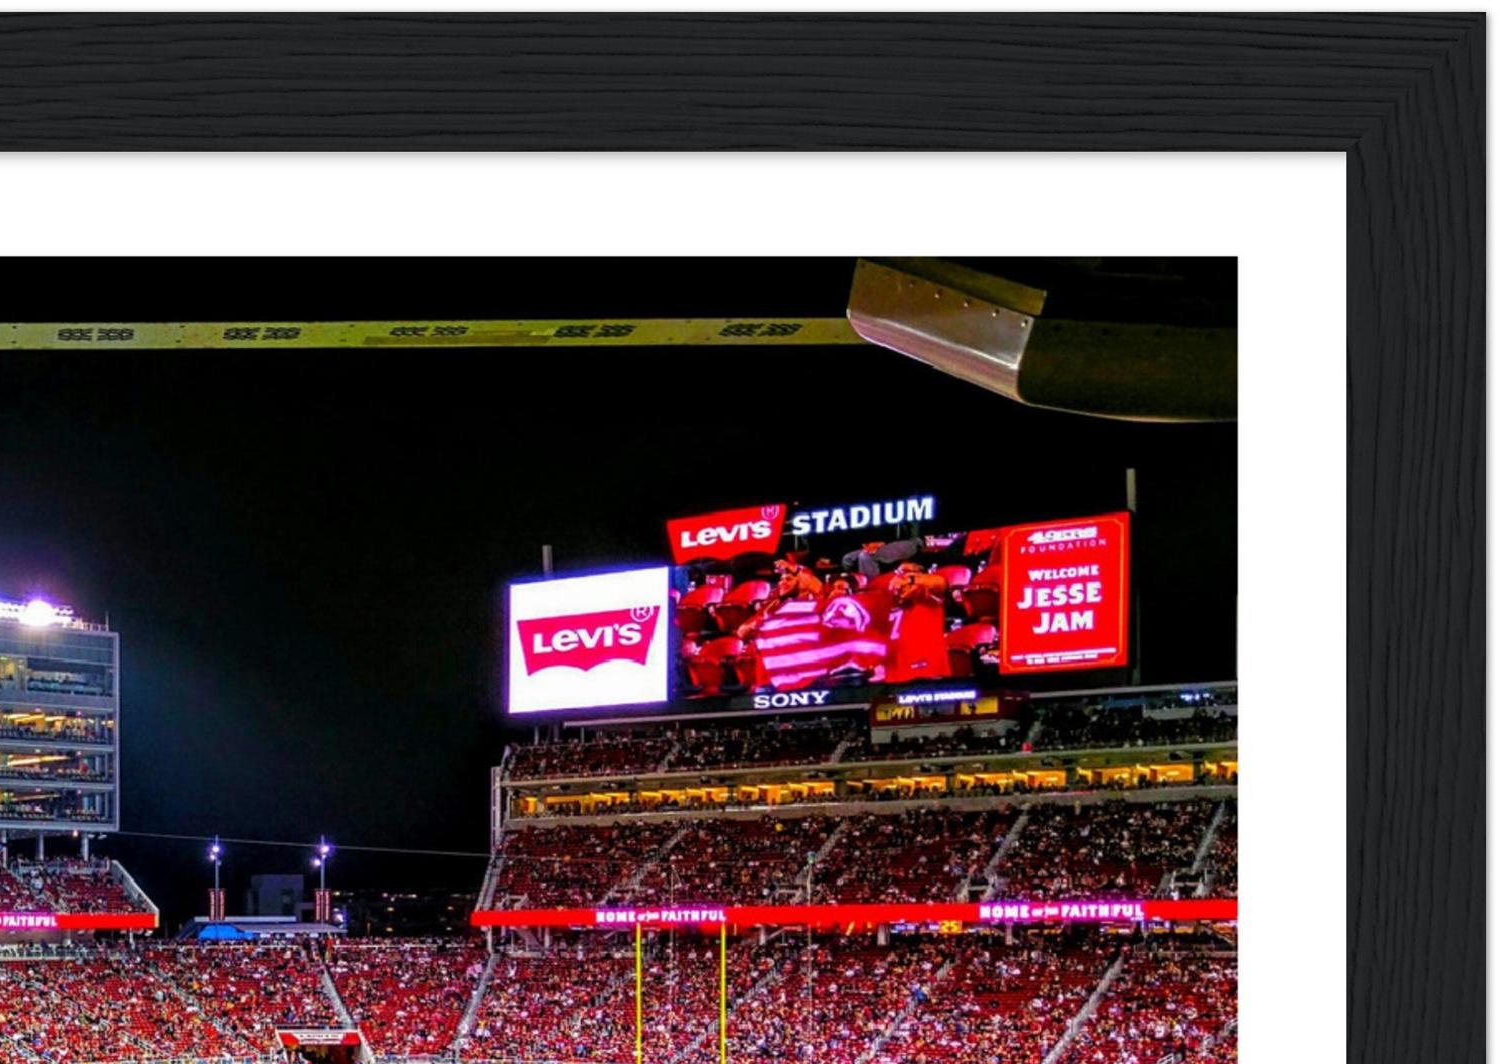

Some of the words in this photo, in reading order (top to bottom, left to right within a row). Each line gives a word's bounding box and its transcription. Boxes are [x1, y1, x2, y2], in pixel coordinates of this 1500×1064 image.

[792, 497, 934, 536] STADIUM
[1020, 538, 1107, 554] FOUNDATION
[1028, 564, 1100, 582] WELCOME
[1016, 581, 1103, 609] JESSE
[1032, 610, 1095, 635] JAM
[753, 691, 830, 709] SONY
[596, 911, 635, 922] HOME
[661, 910, 727, 922] FAITHFUL
[979, 905, 1030, 919] HOME
[1061, 903, 1145, 918] FAITHFUL
[3, 915, 58, 927] FAITHFUL
